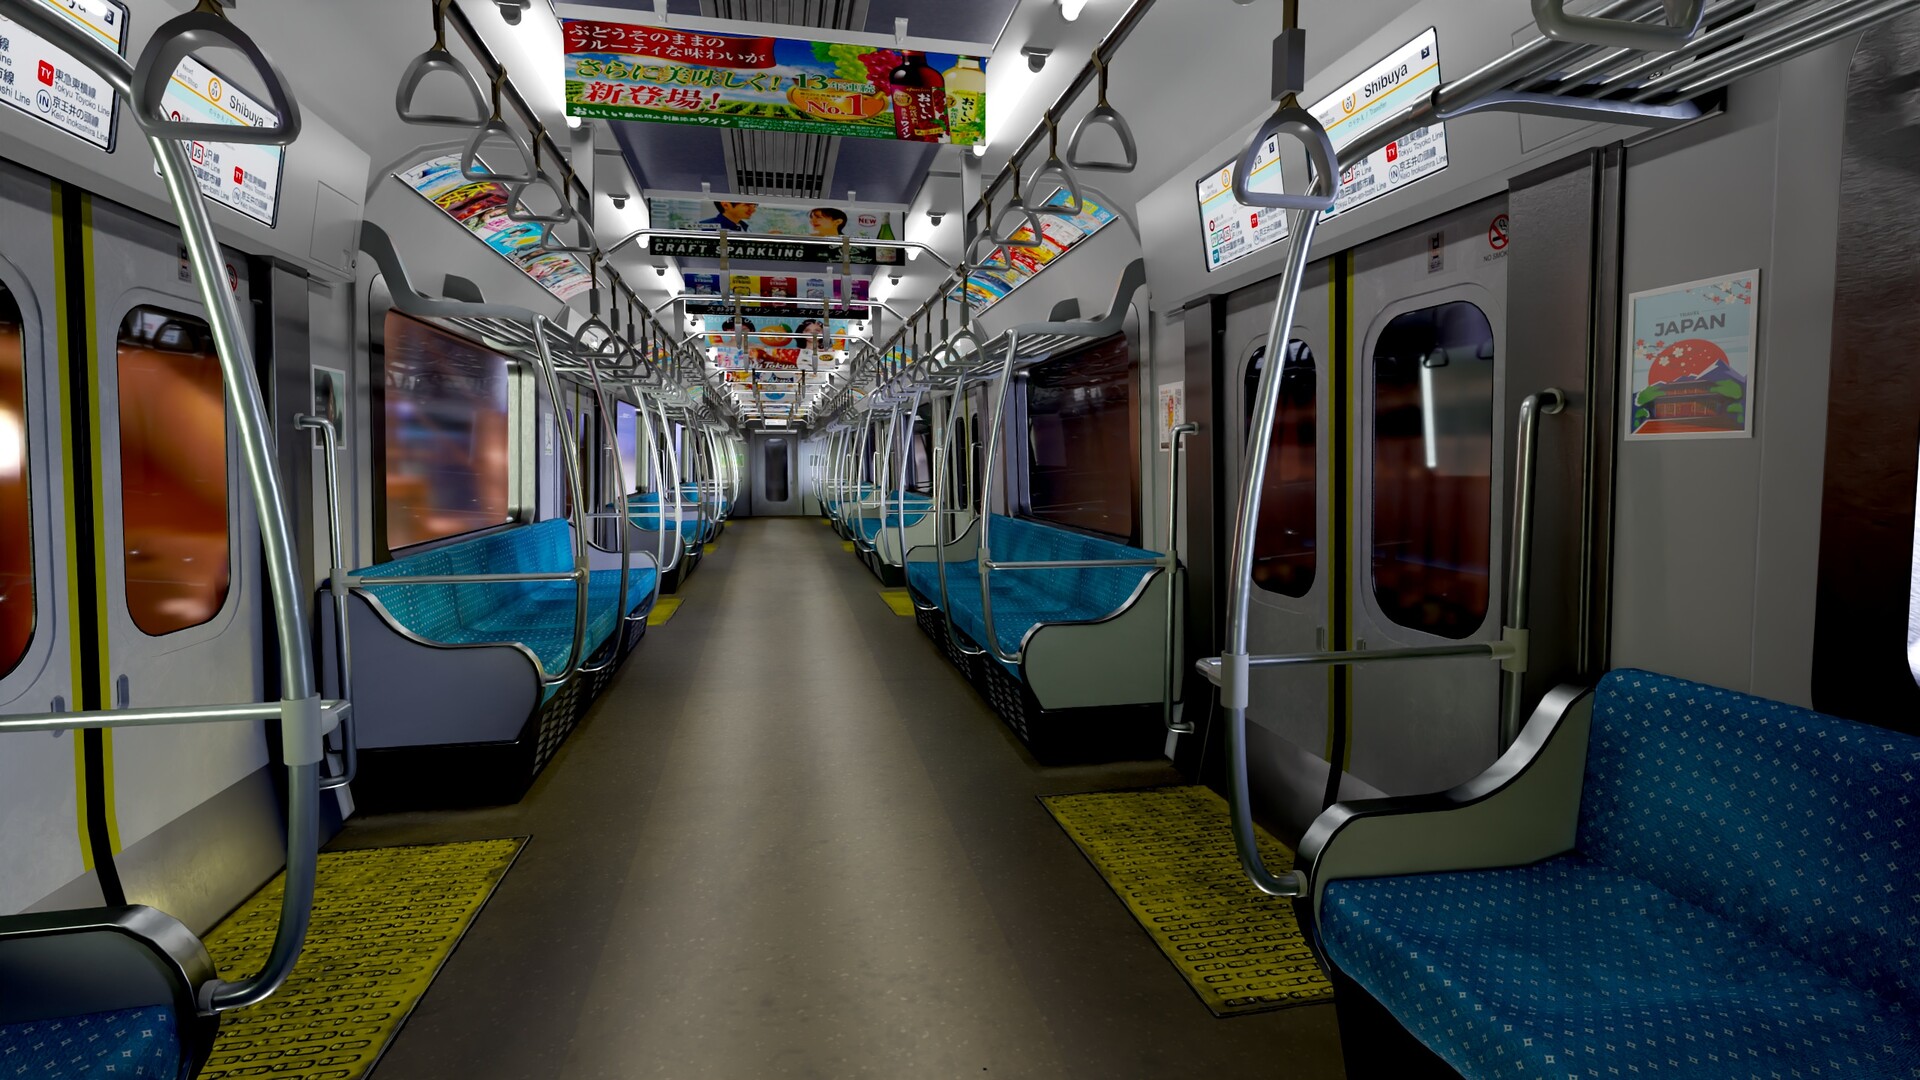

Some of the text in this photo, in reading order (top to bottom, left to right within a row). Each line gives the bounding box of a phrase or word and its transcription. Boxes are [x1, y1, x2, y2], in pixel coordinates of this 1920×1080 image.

[569, 25, 725, 48] ぶどうそのままの
[571, 38, 766, 63] フルーティな味わいが
[40, 66, 52, 80] TY
[1364, 63, 1408, 98] Shibuya
[14, 90, 31, 106] Line
[39, 95, 50, 108] IN
[54, 82, 111, 117] Tokyu Toyoko Line
[586, 81, 721, 110] 新登場！
[806, 94, 869, 117] No.1
[229, 95, 264, 127] Shibuya
[655, 243, 708, 253] CRAFT
[716, 246, 804, 258] SPARKLING
[1492, 251, 1509, 260] SMOK
[1654, 313, 1726, 337] JAPAN
